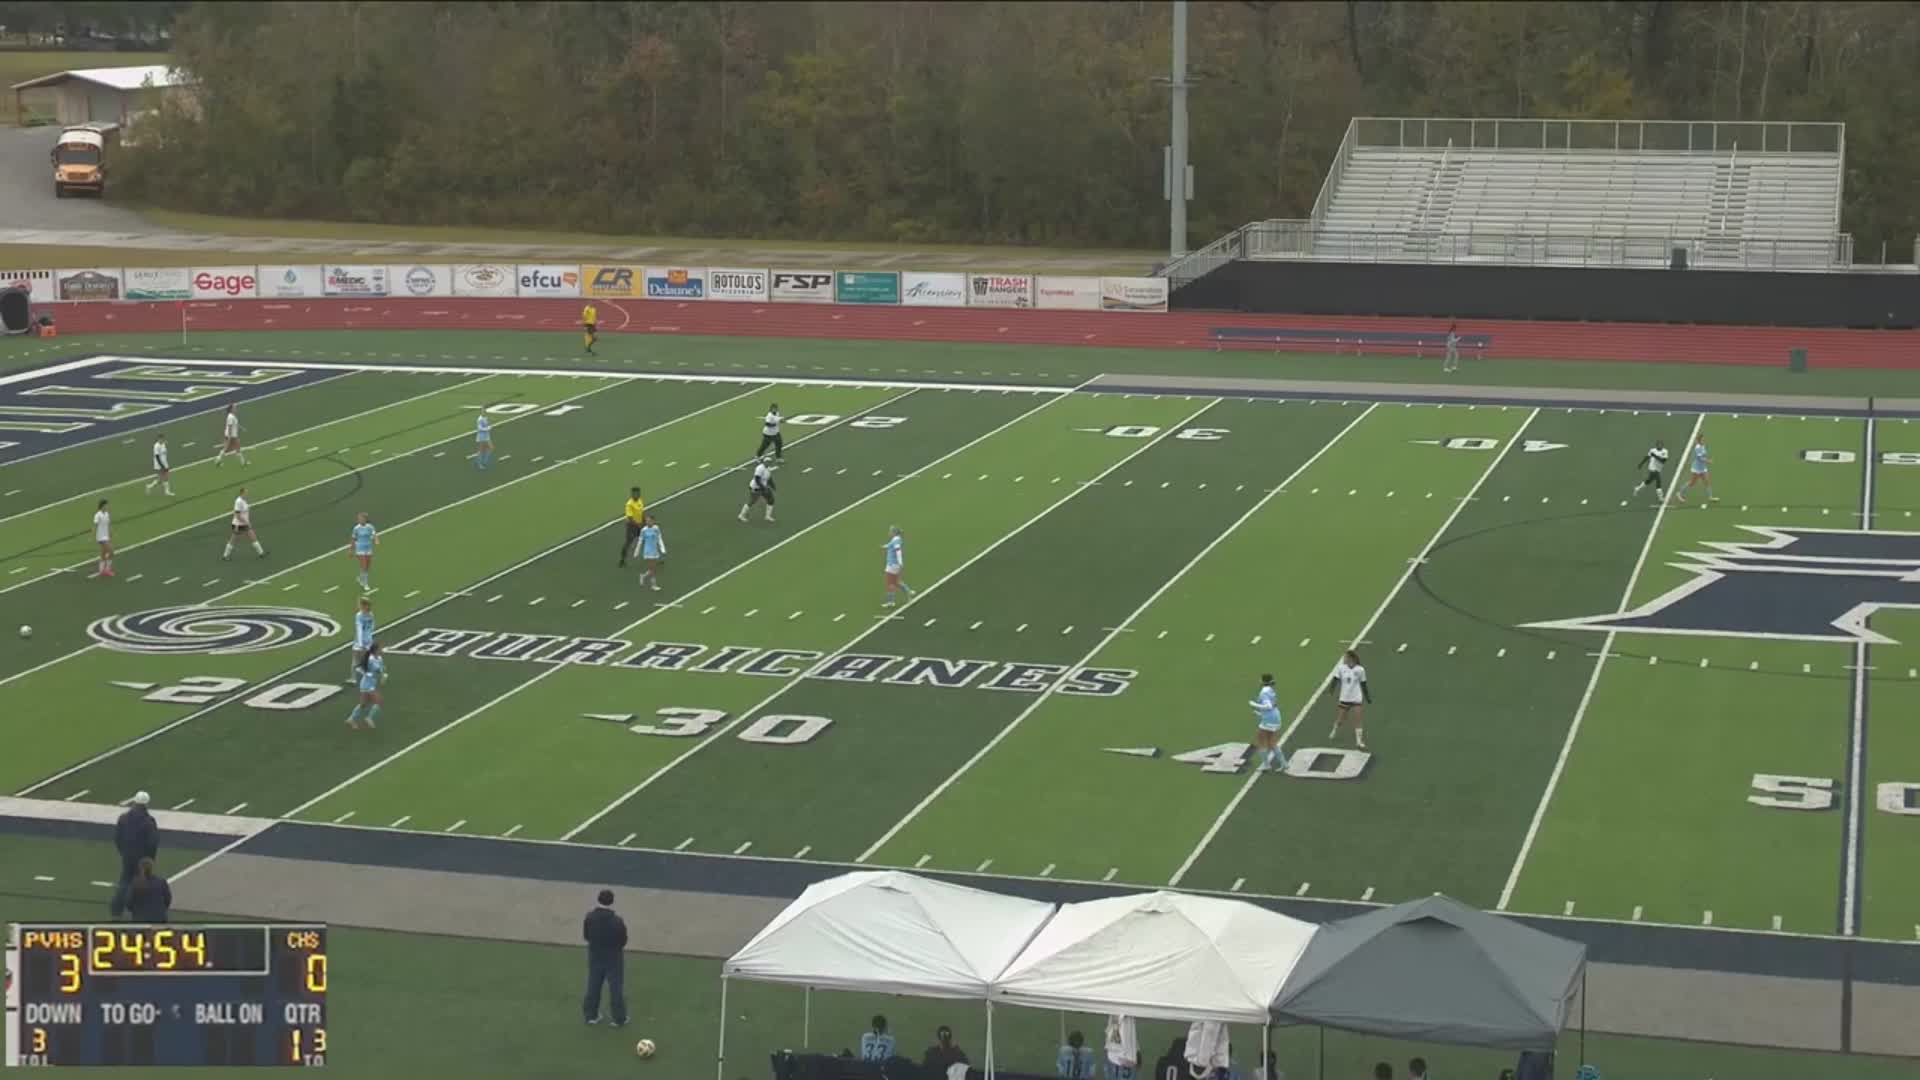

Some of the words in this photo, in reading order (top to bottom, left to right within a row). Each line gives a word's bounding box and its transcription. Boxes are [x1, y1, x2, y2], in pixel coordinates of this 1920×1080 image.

[193, 273, 254, 295] Gage
[521, 270, 561, 288] efcu
[592, 268, 633, 286] CR
[774, 274, 831, 288] FSP
[991, 278, 1027, 287] TRASH
[382, 627, 1138, 698] HURRICANES
[142, 676, 342, 709] 20
[628, 706, 833, 744] 30
[1170, 742, 1372, 779] 40
